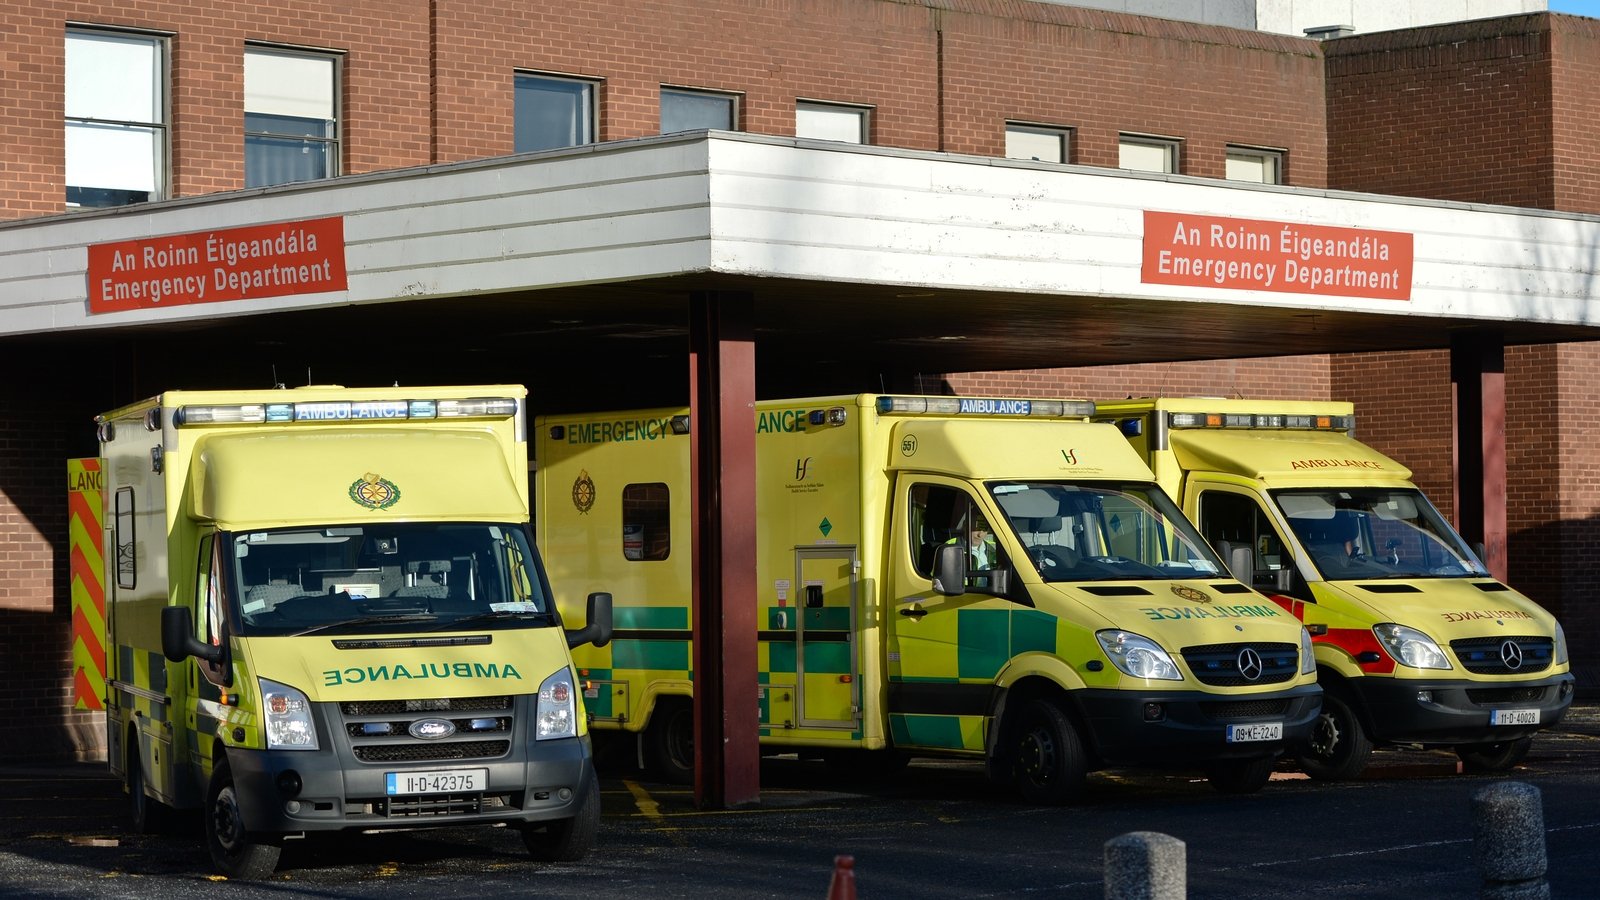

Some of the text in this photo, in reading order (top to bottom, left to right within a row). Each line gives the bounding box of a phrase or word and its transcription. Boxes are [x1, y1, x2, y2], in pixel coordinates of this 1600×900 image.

[1173, 222, 1389, 261] An Roinn Éigeandála
[112, 230, 317, 272] An Roinn Éigeandála
[1158, 250, 1399, 290] Emergency Department
[102, 258, 331, 301] Emergency Department
[297, 401, 407, 419] AMBULANCE
[961, 399, 1029, 414] AMBULANCE
[568, 418, 669, 444] EMERGENCY
[902, 440, 915, 451] 551
[1291, 458, 1384, 470] AMBULANCE
[1501, 712, 1536, 724] 11-D-40028
[420, 723, 446, 734] Ford
[1235, 726, 1279, 740] 09-KE-2240
[407, 775, 474, 792] 11-D-42375
